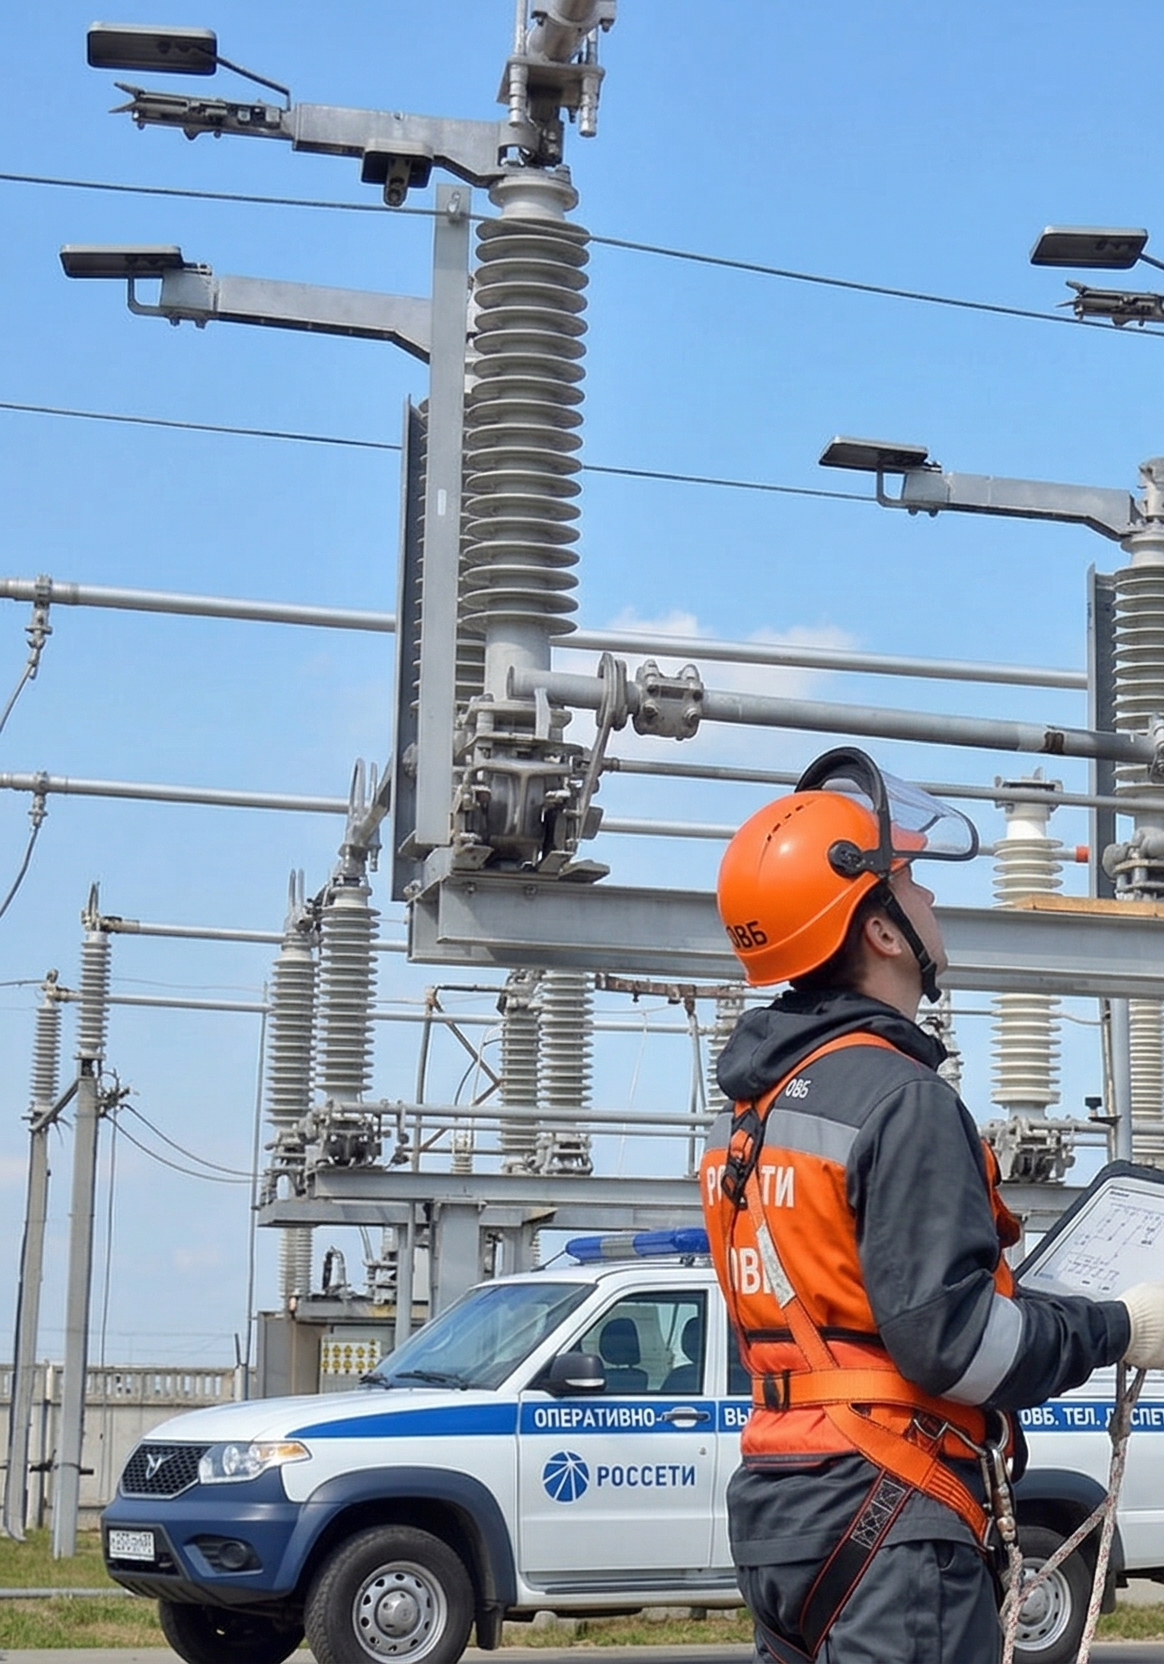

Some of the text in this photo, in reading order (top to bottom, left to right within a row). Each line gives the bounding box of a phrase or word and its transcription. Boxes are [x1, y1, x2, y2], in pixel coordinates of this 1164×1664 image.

[725, 920, 768, 949] ОВБ
[534, 1407, 662, 1428] ОПЕРАТИВНО-
[1062, 1406, 1101, 1427] ТЕЛ.
[596, 1465, 696, 1488] РОССЕТИ
